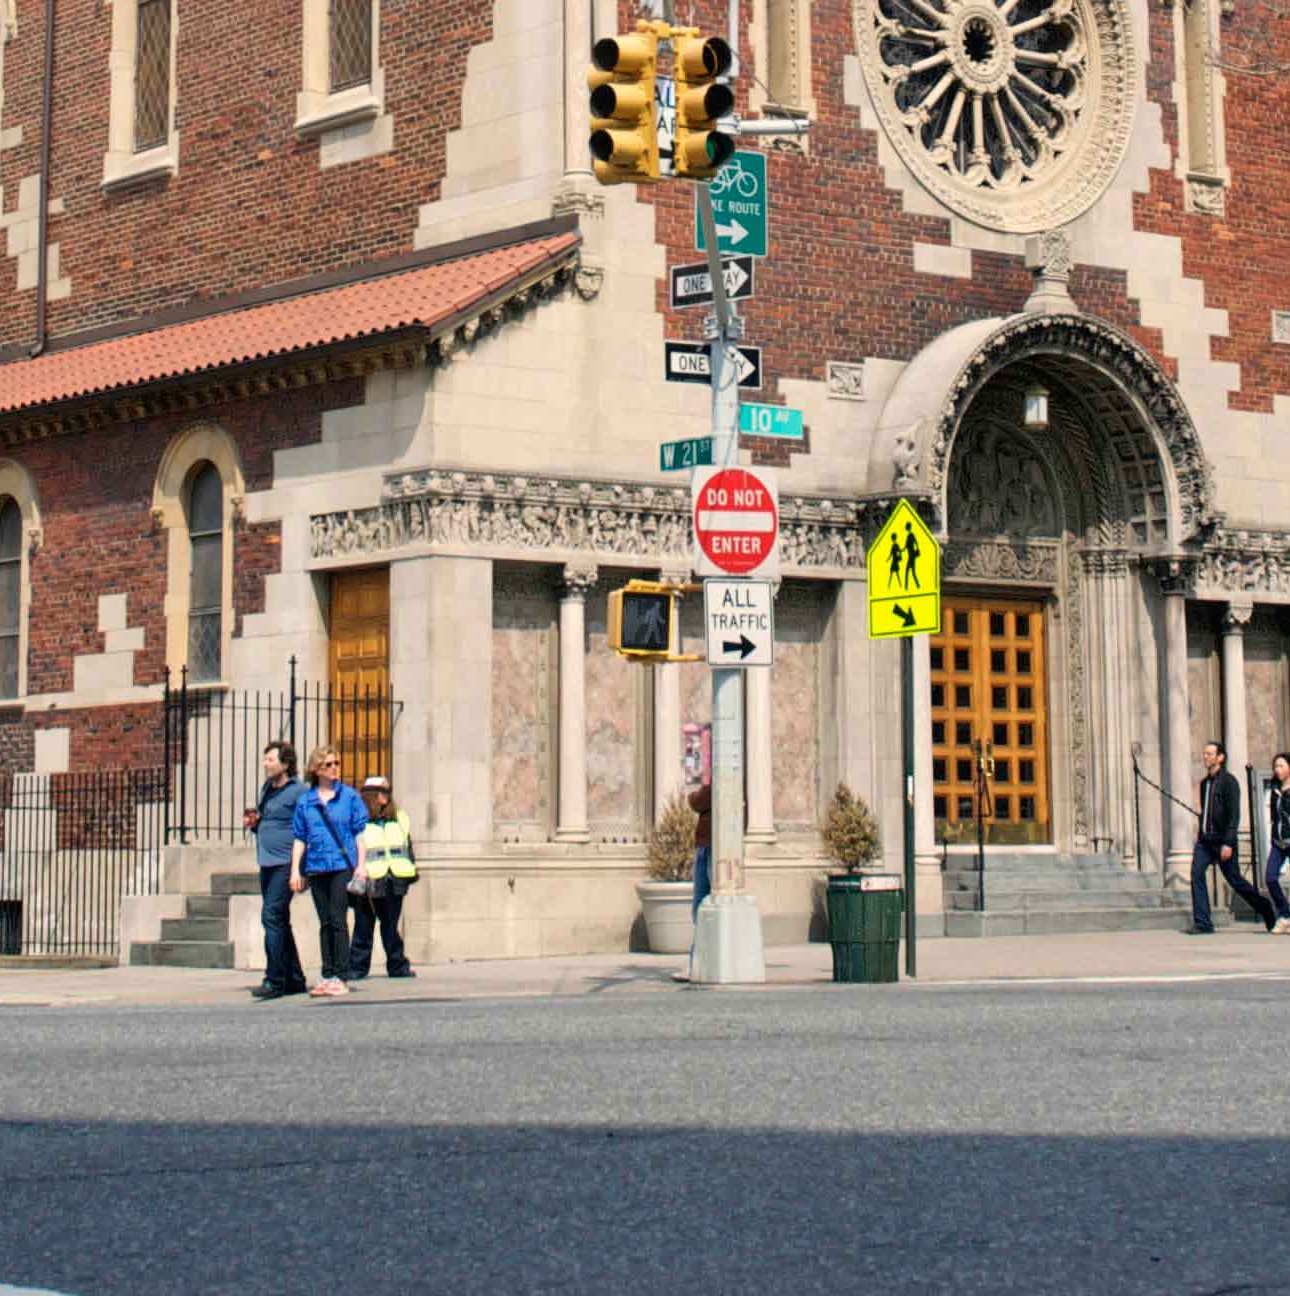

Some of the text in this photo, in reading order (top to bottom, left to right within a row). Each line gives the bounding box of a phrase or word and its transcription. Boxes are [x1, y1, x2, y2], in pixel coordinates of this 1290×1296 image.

[728, 200, 762, 216] ROUTE
[683, 270, 741, 293] ONE AY
[678, 354, 706, 372] ONE
[749, 407, 772, 433] 10
[663, 444, 675, 468] W
[682, 442, 698, 466] 21
[707, 488, 764, 507] DO NOT
[712, 535, 763, 554] ENTER
[722, 588, 758, 608] ALL
[711, 613, 768, 631] TRAFFIC
